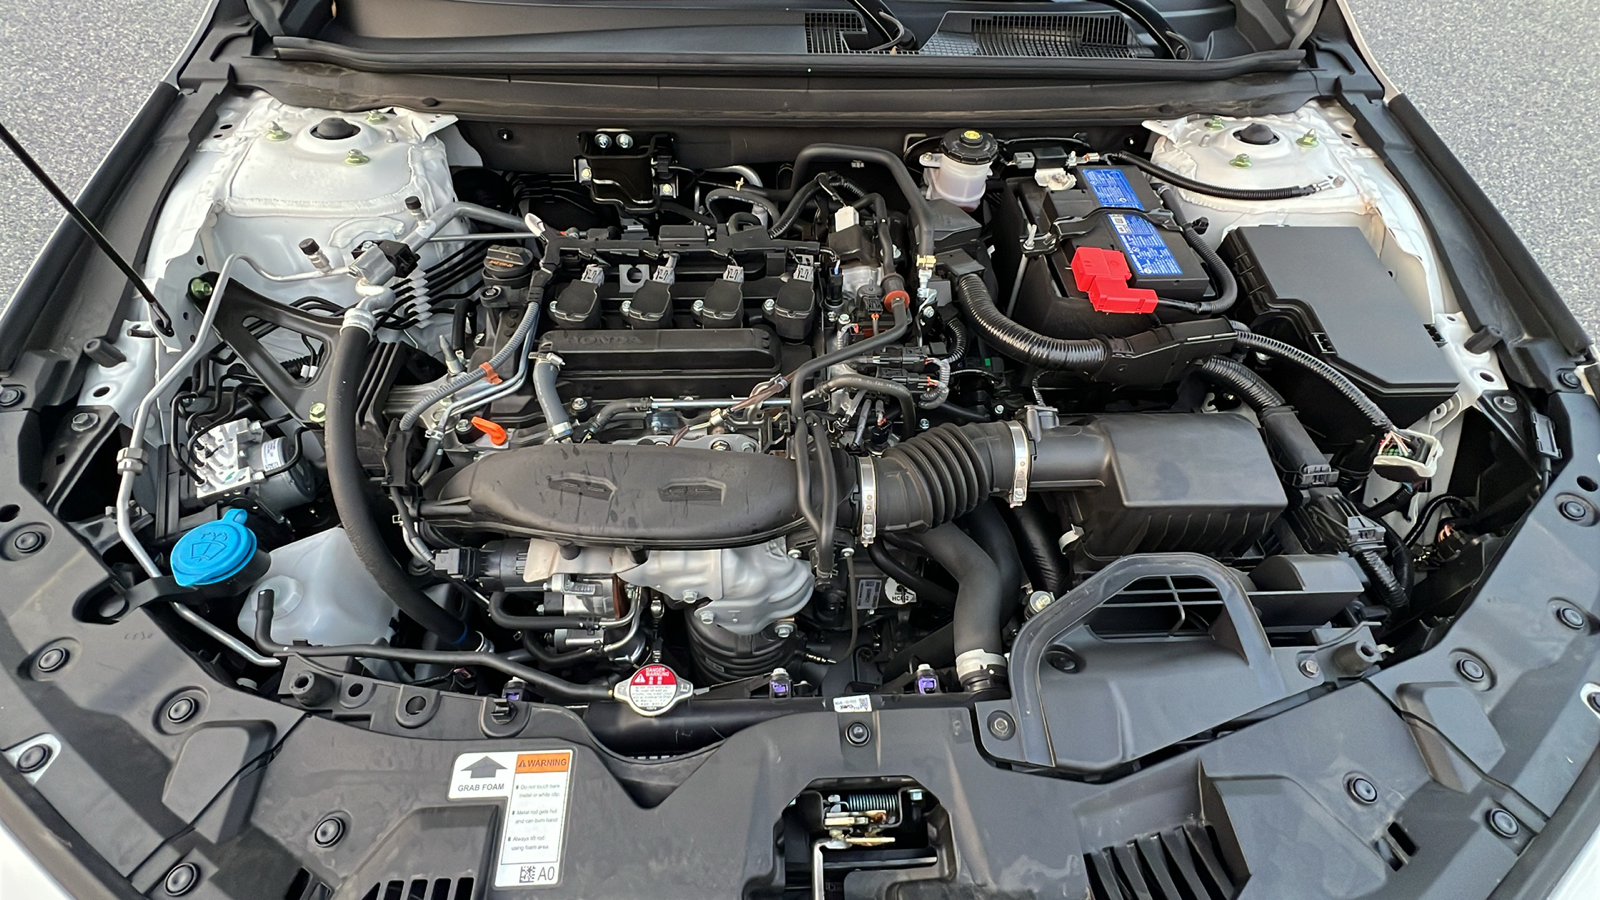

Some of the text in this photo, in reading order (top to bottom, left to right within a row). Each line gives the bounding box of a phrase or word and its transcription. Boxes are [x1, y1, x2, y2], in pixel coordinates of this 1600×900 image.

[567, 335, 644, 345] HONDA
[891, 594, 909, 602] HC2
[527, 759, 567, 768] WARNING
[537, 866, 555, 881] A0
